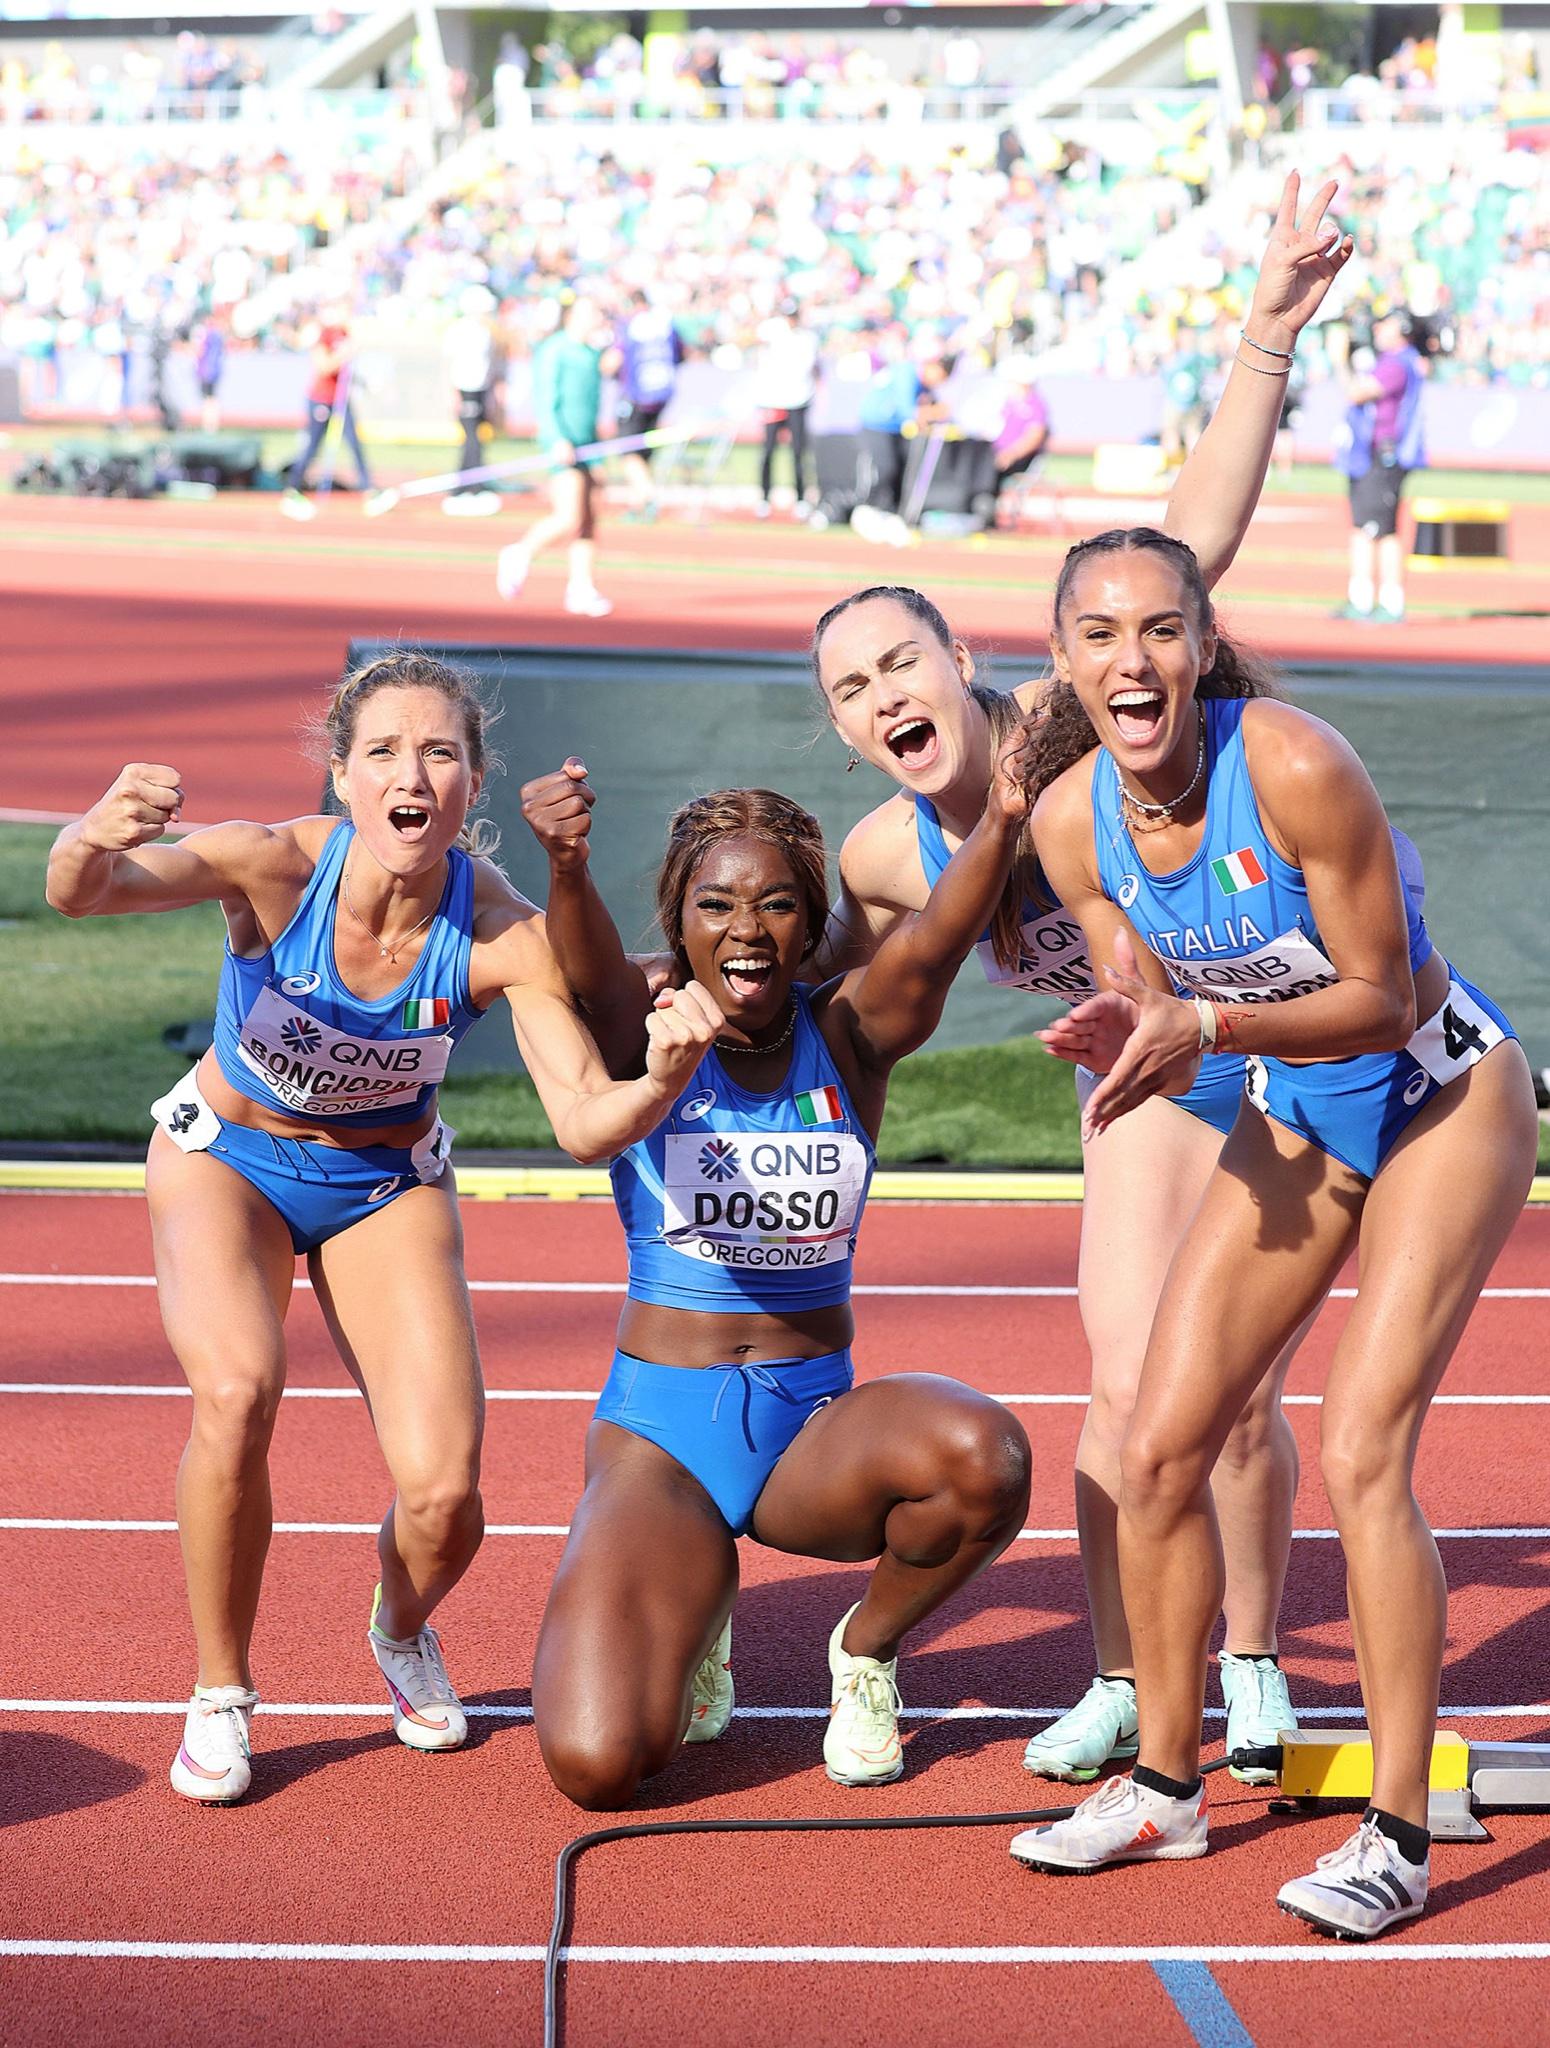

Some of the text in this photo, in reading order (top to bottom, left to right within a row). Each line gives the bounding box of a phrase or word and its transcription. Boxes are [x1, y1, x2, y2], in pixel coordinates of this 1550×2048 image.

[1149, 916, 1266, 958] ITALIA
[1201, 956, 1291, 984] QNB
[1443, 1003, 1488, 1061] 4
[329, 1043, 422, 1072] QNB
[264, 1072, 389, 1113] OREGON22
[750, 1143, 841, 1177] QNB
[694, 1189, 839, 1232] DOSSO
[698, 1240, 828, 1266] OREGON22
